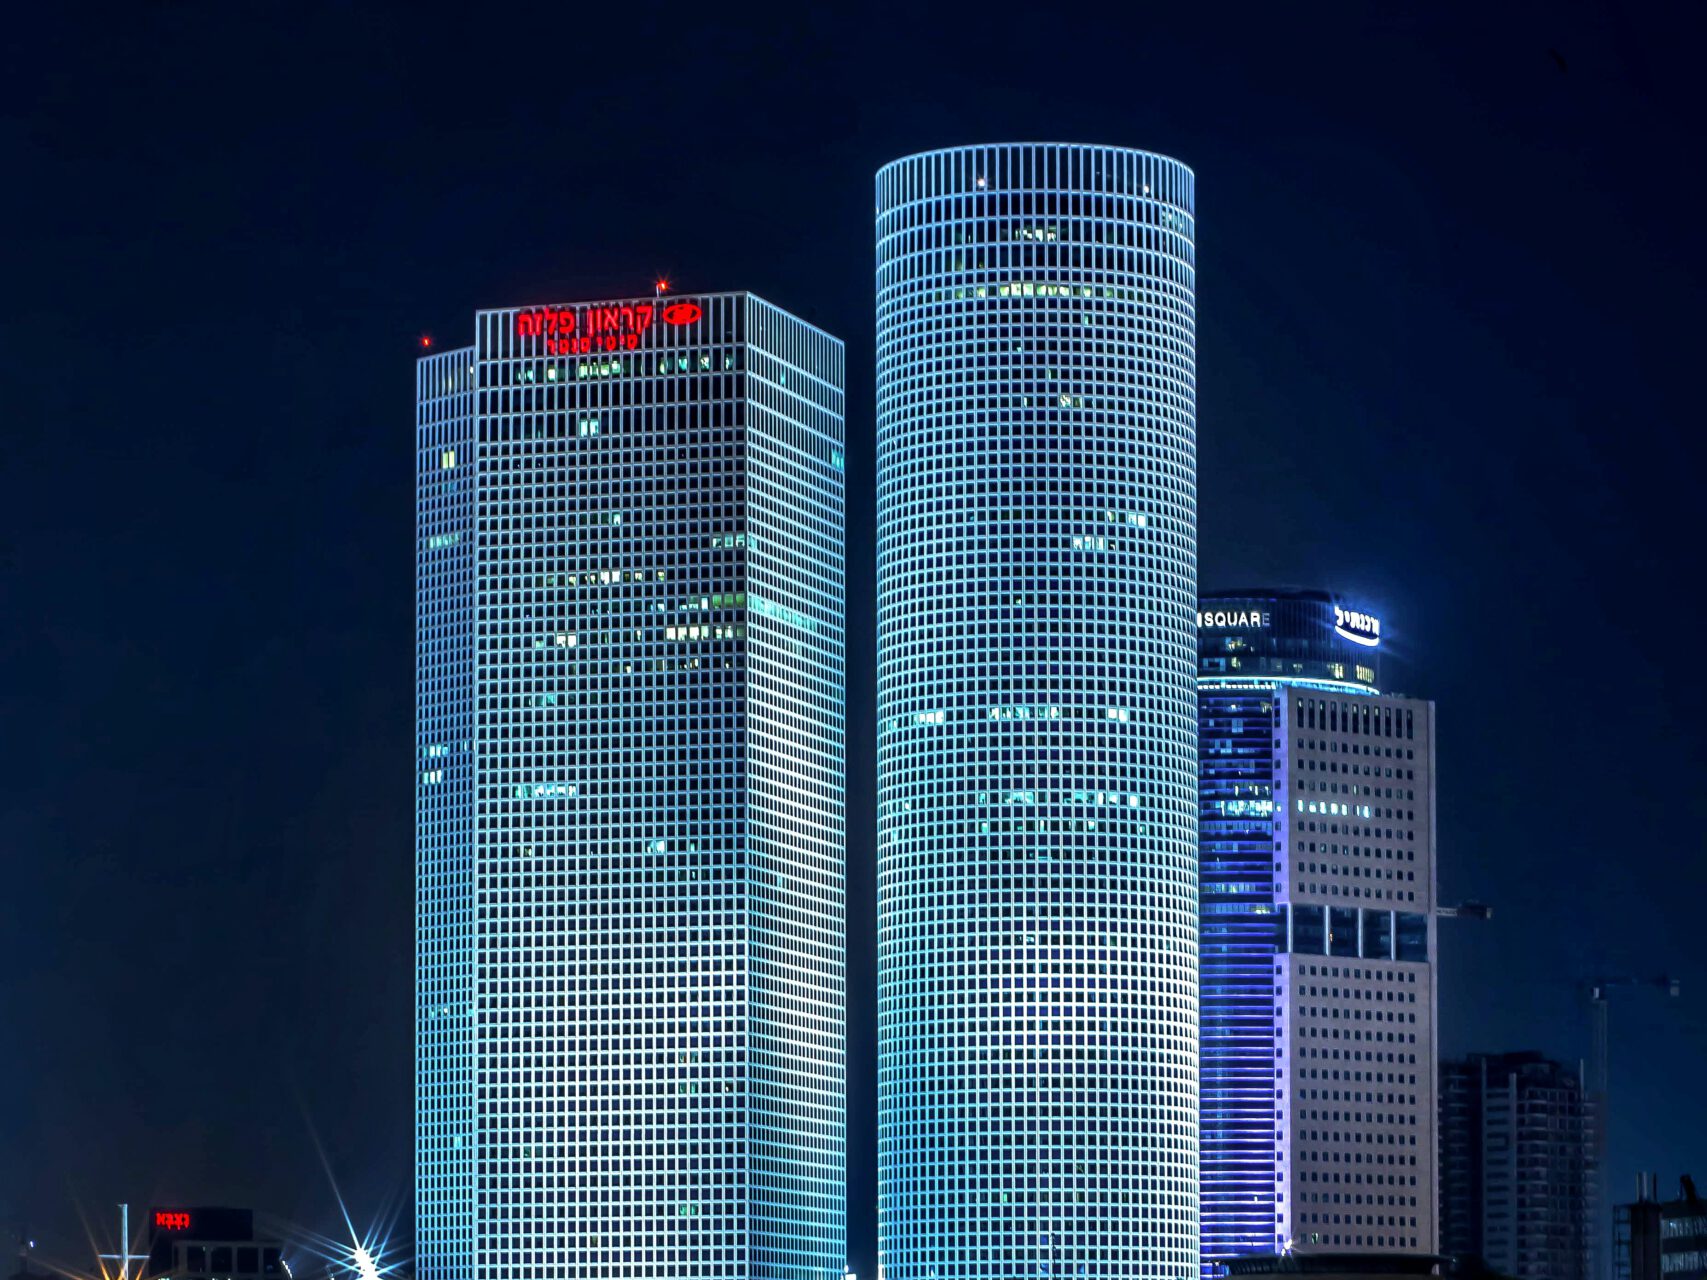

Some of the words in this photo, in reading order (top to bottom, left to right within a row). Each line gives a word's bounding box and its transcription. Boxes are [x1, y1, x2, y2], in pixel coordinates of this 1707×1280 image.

[517, 307, 575, 336] פלזה
[586, 304, 653, 337] קראון
[547, 337, 590, 355] סנטר
[596, 333, 639, 351] סיטי
[1204, 611, 1271, 628] SQUARE
